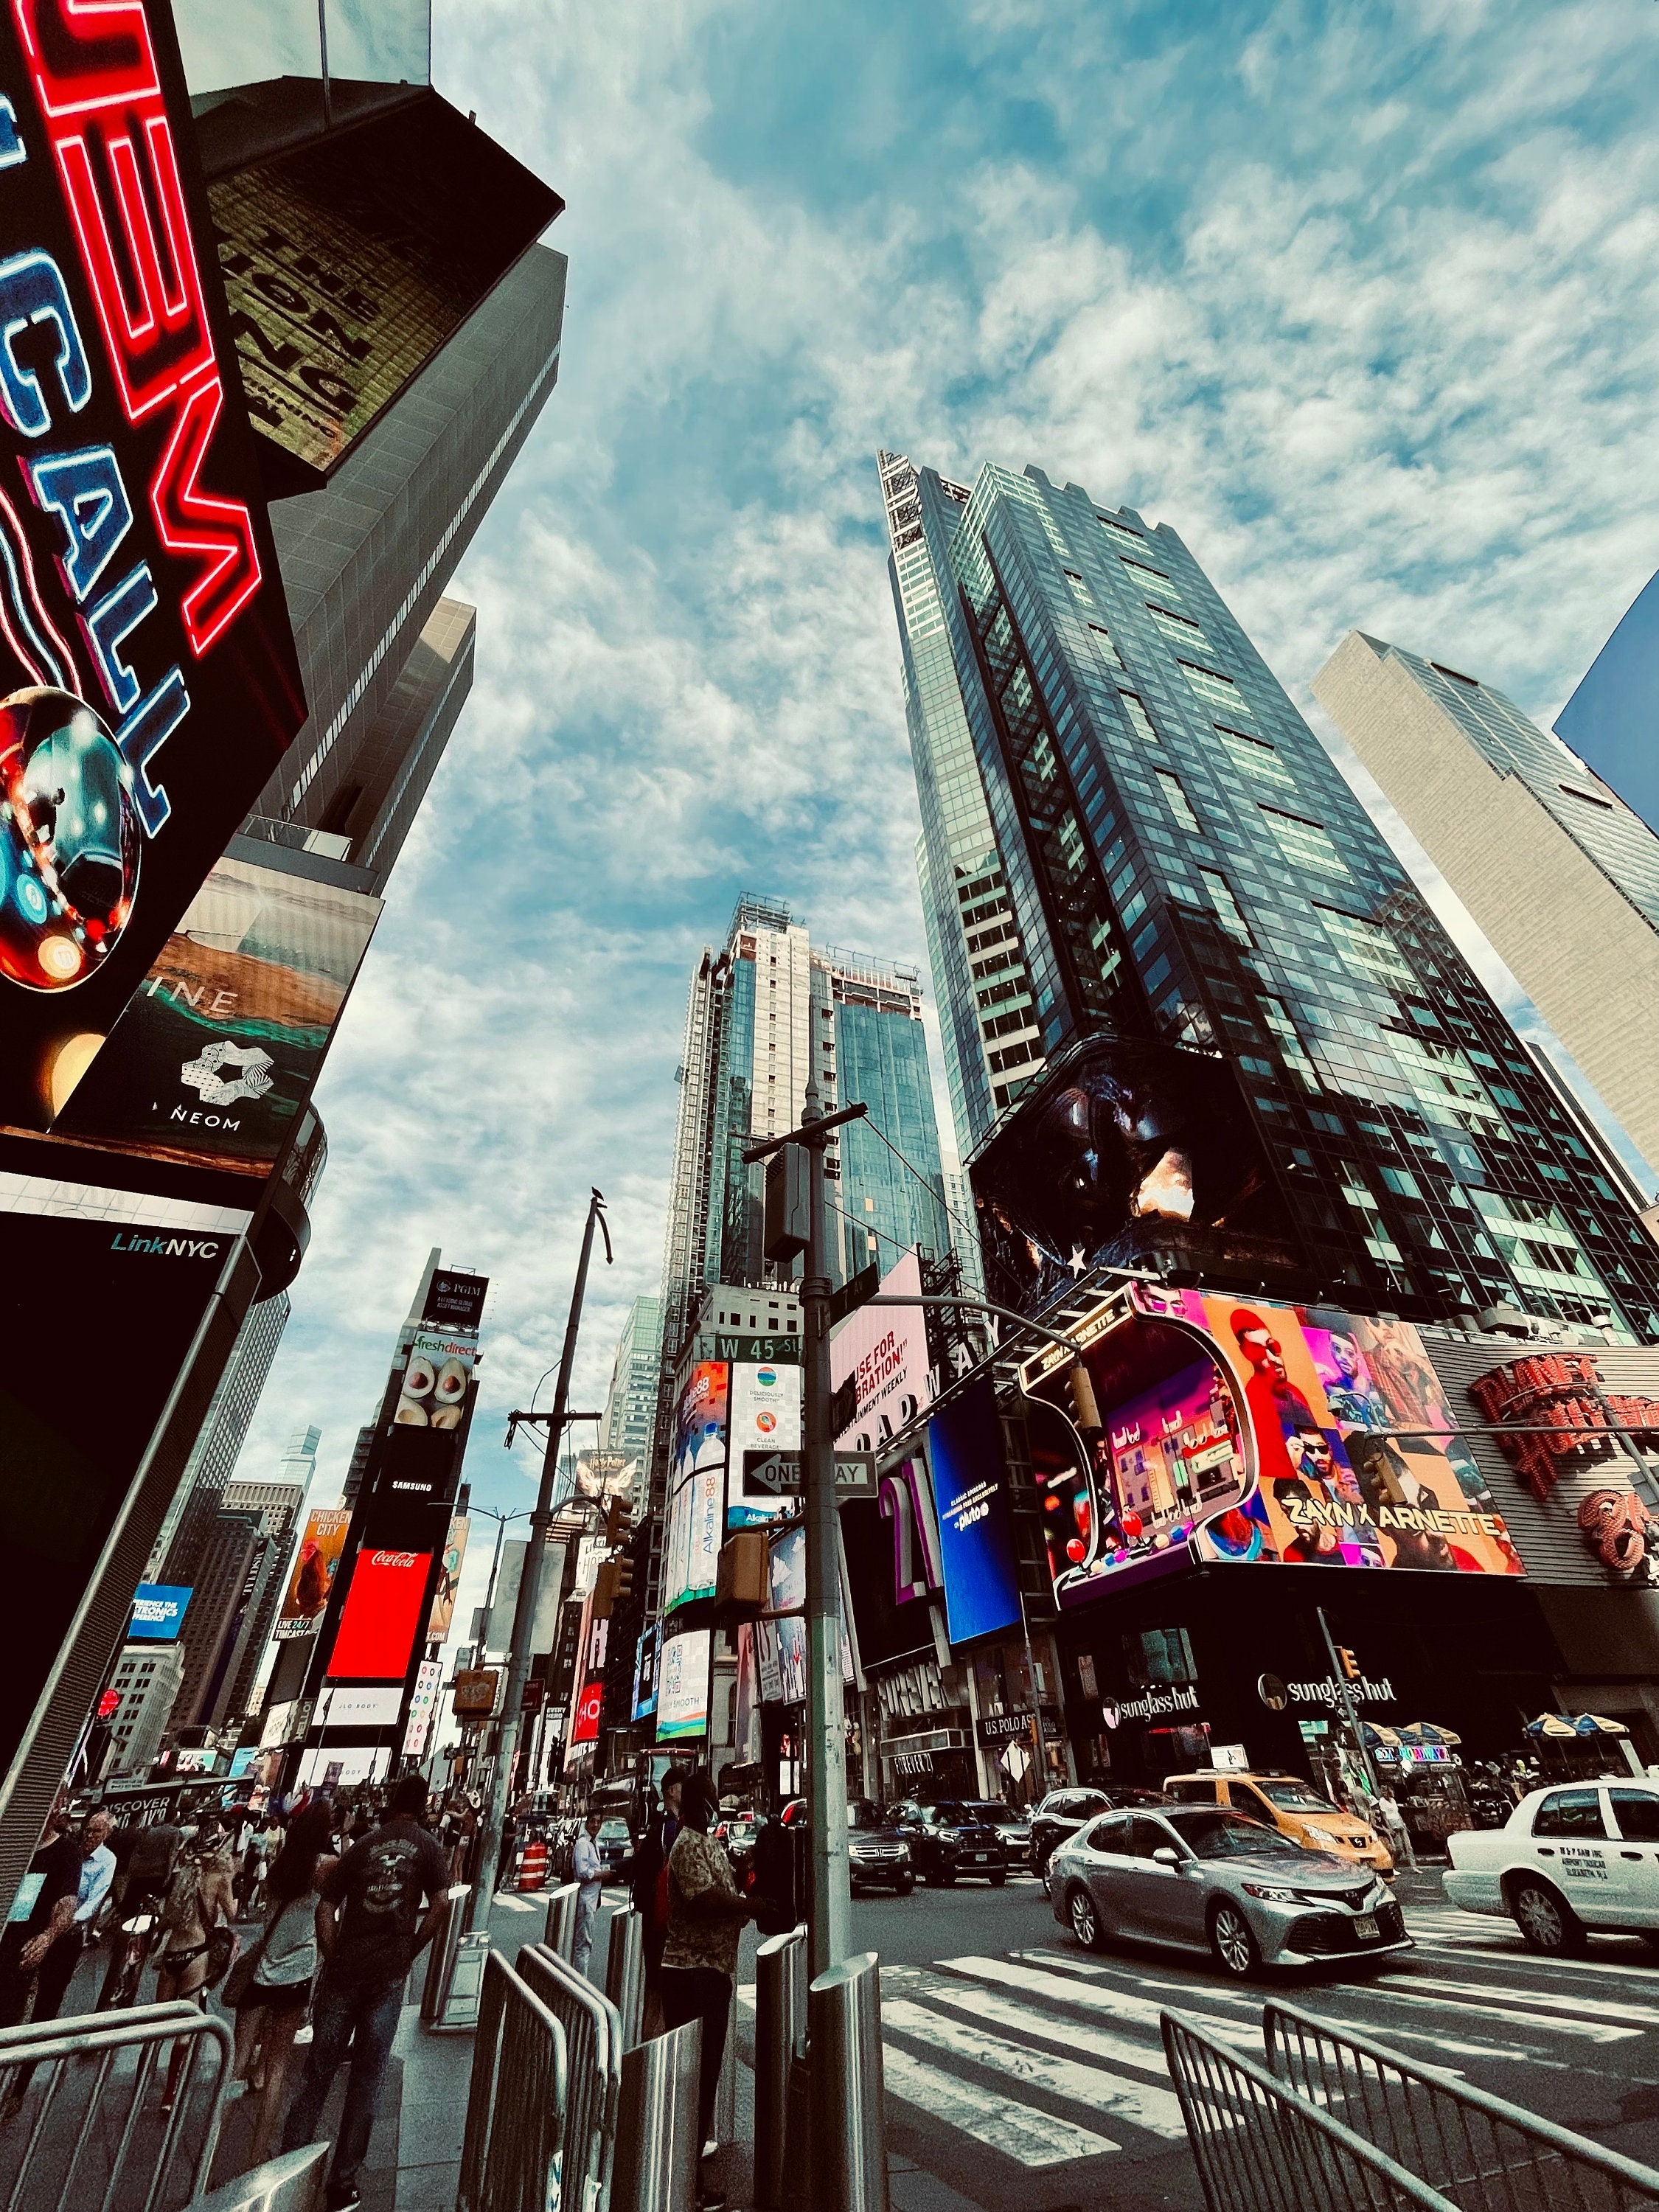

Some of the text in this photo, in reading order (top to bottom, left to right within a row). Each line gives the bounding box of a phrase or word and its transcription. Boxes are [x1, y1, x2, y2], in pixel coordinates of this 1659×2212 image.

[146, 976, 239, 1015] INE
[170, 1108, 241, 1132] NEOM
[111, 1232, 219, 1259] LinkNYC
[454, 1284, 481, 1295] PGIM
[417, 1335, 476, 1357] freshdirect
[720, 1338, 797, 1360] W 45 St
[854, 1330, 895, 1383] USE FOR
[1040, 1345, 1065, 1371] ZAYN
[749, 1390, 784, 1398] DELICIOUSLY
[881, 1366, 908, 1400] WEEKLY
[589, 1455, 626, 1470] Harry Potter
[765, 1464, 859, 1483] ONE AY
[392, 1480, 432, 1492] SAMSUNG
[310, 1510, 352, 1524] CHICKEN
[703, 1476, 717, 1554] Alkaline88
[959, 1506, 981, 1532] pluto
[1281, 1498, 1502, 1536] ZAYN X ARNETTE
[316, 1523, 339, 1536] CITY
[371, 1550, 420, 1568] Coca-Cola
[277, 1620, 310, 1630] LIVE 24/7
[672, 1697, 700, 1708] SMOOTH
[1287, 1675, 1397, 1708] sunglass hut
[1120, 1686, 1200, 1722] sunglass hut
[985, 1720, 999, 1736] U.S.
[998, 1716, 1020, 1733] POLO
[894, 1754, 925, 1775] FOREVER
